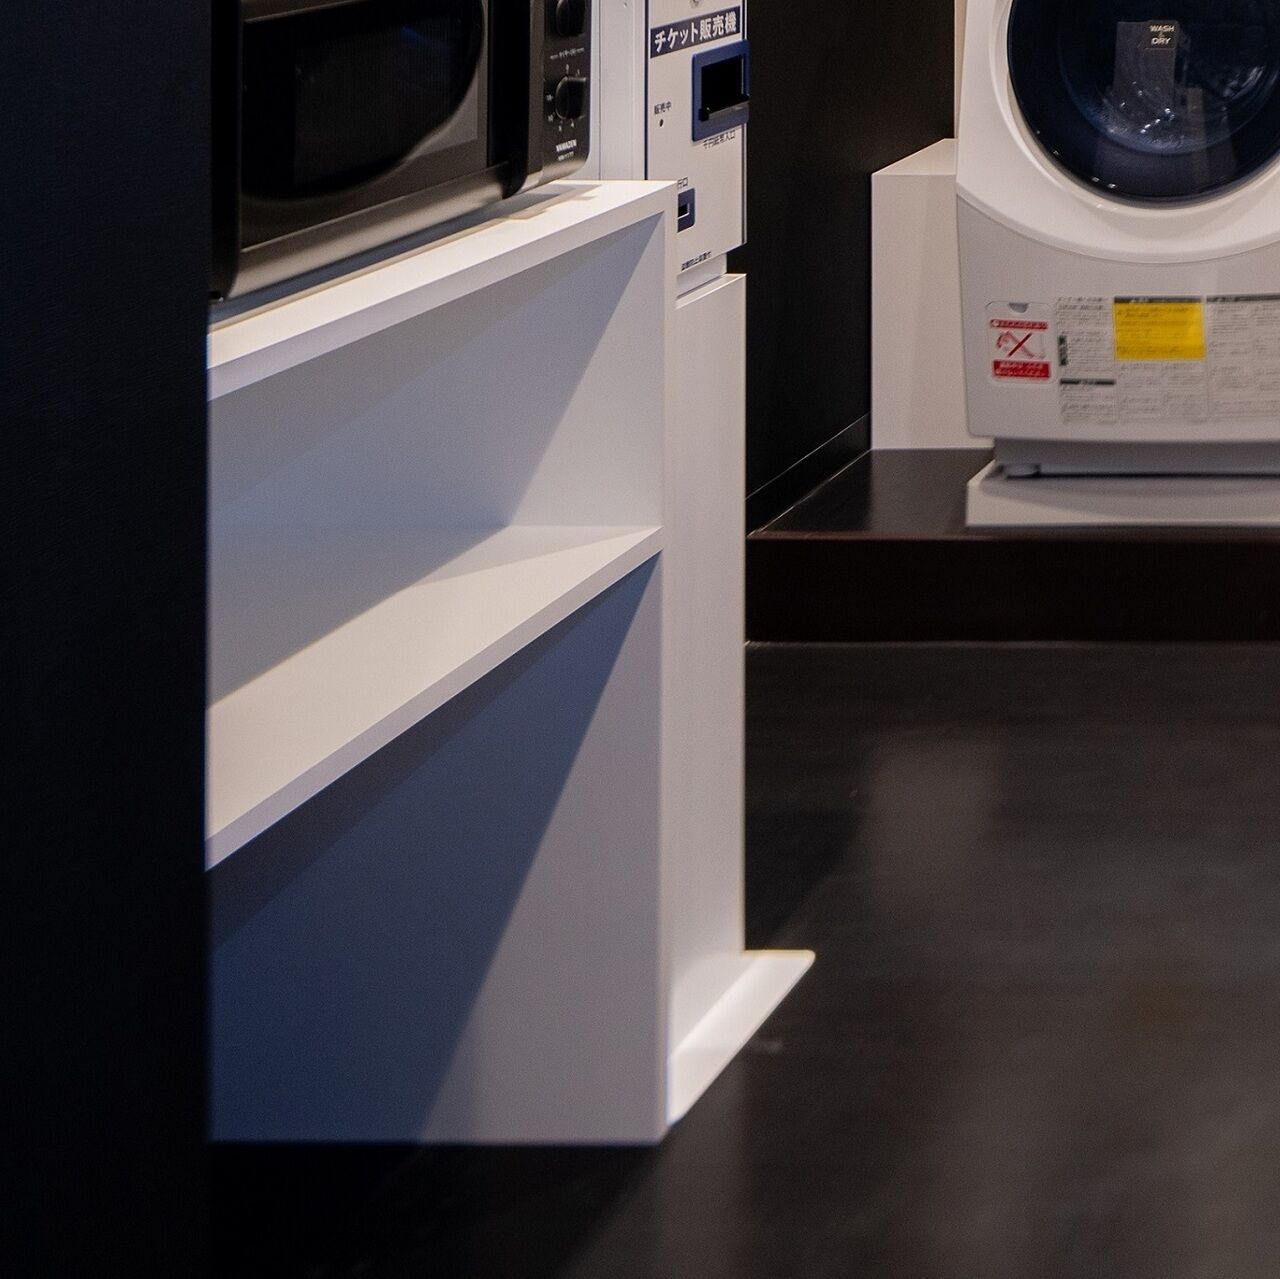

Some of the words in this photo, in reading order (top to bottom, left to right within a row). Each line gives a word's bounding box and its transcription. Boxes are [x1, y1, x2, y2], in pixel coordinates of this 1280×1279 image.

[654, 11, 737, 53] チケット販売機
[1151, 37, 1171, 45] DRY
[653, 101, 672, 115] 販売中
